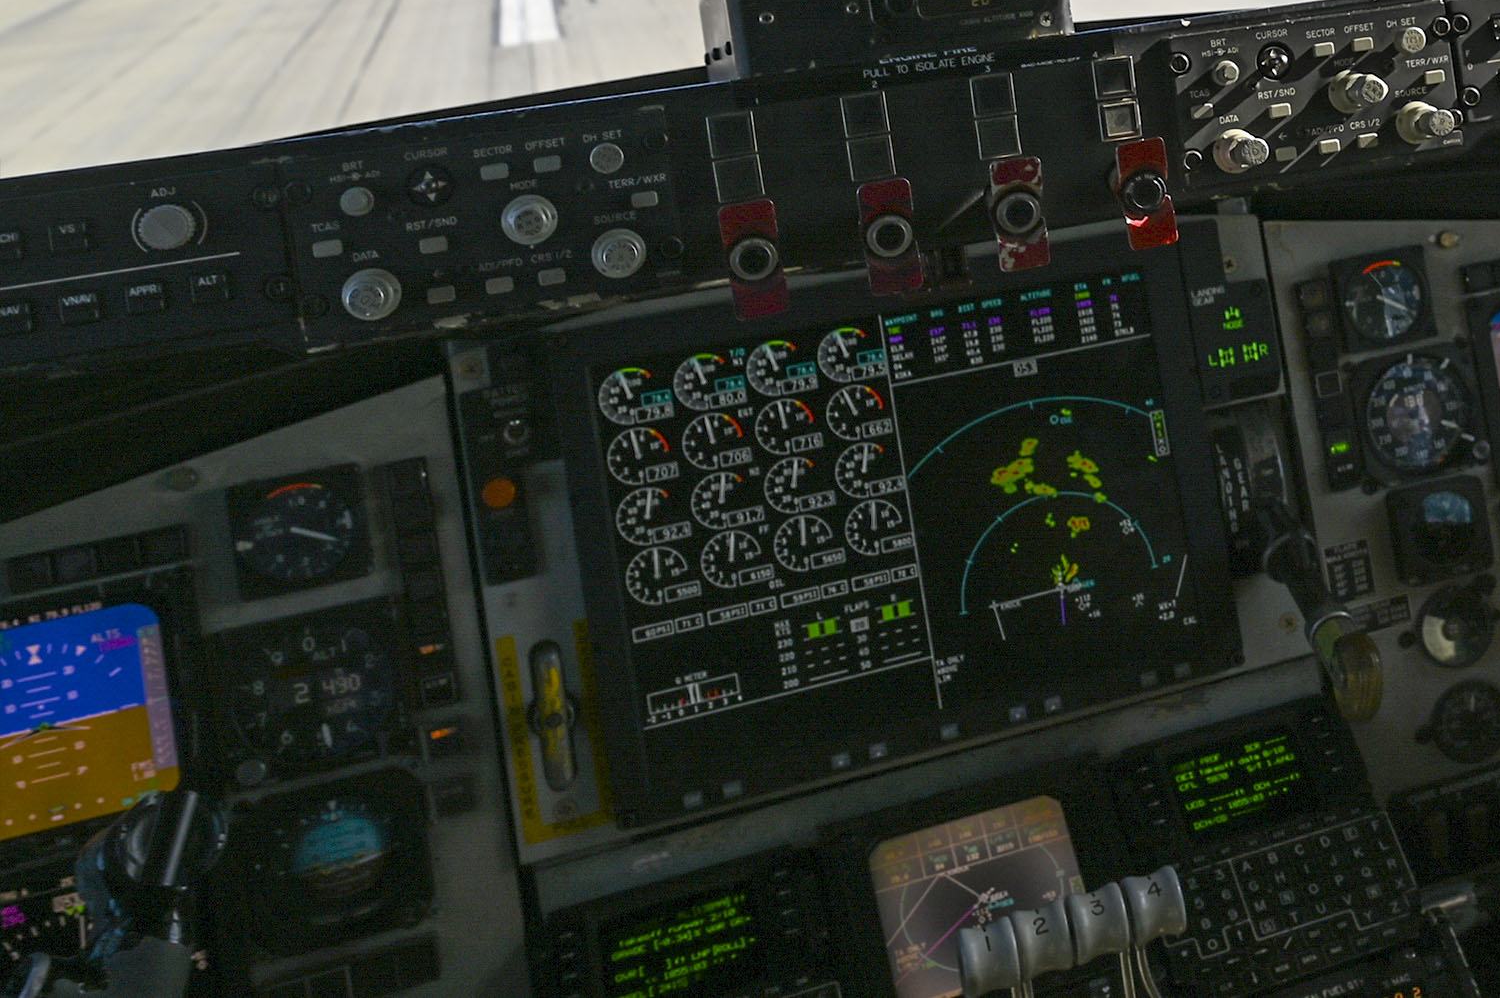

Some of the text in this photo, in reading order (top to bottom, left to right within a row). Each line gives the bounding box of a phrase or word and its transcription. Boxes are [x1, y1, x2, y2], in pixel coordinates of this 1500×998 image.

[1343, 21, 1375, 34] OFFSET
[1385, 16, 1417, 29] DH SET
[1255, 28, 1288, 41] CURSOR
[1305, 27, 1336, 40] SECTOR
[1210, 38, 1227, 48] BRT
[863, 51, 996, 80] PULL TO ISOLATE ENGINE
[1333, 58, 1355, 69] MODE
[1405, 55, 1449, 69] TERR/WXR
[985, 65, 992, 74] 3
[872, 79, 879, 89] 2
[1189, 89, 1211, 99] TCAS
[1257, 87, 1296, 100] RST/SND
[1394, 86, 1427, 98] SOURCE
[1218, 114, 1240, 126] DATA
[1349, 117, 1381, 131] CRS 1/2
[582, 129, 623, 144] DH SET
[472, 144, 513, 159] SECTOR
[525, 137, 565, 152] OFFSET
[403, 147, 448, 162] CURSOR
[342, 161, 363, 173] BRT
[509, 179, 538, 192] MODE
[607, 172, 667, 190] TERR/WXR
[150, 186, 177, 198] ADJ
[405, 216, 458, 232] RST/SND
[593, 210, 637, 226] SOURCE
[59, 224, 76, 235] VS
[311, 220, 341, 234] TCAS
[351, 249, 379, 263] DATA
[530, 253, 553, 266] CRS
[477, 257, 523, 274] ADI/PFD
[198, 274, 218, 288] ALT
[128, 283, 152, 297] APPR
[62, 293, 93, 307] VNAV
[1260, 342, 1269, 357] R
[1208, 353, 1219, 367] L
[868, 420, 891, 434] 662
[798, 435, 821, 449] 716
[727, 450, 750, 464] 706
[653, 465, 677, 479] 707
[844, 600, 870, 614] FLAPS
[1147, 880, 1162, 898] 4
[1033, 917, 1049, 937] 2
